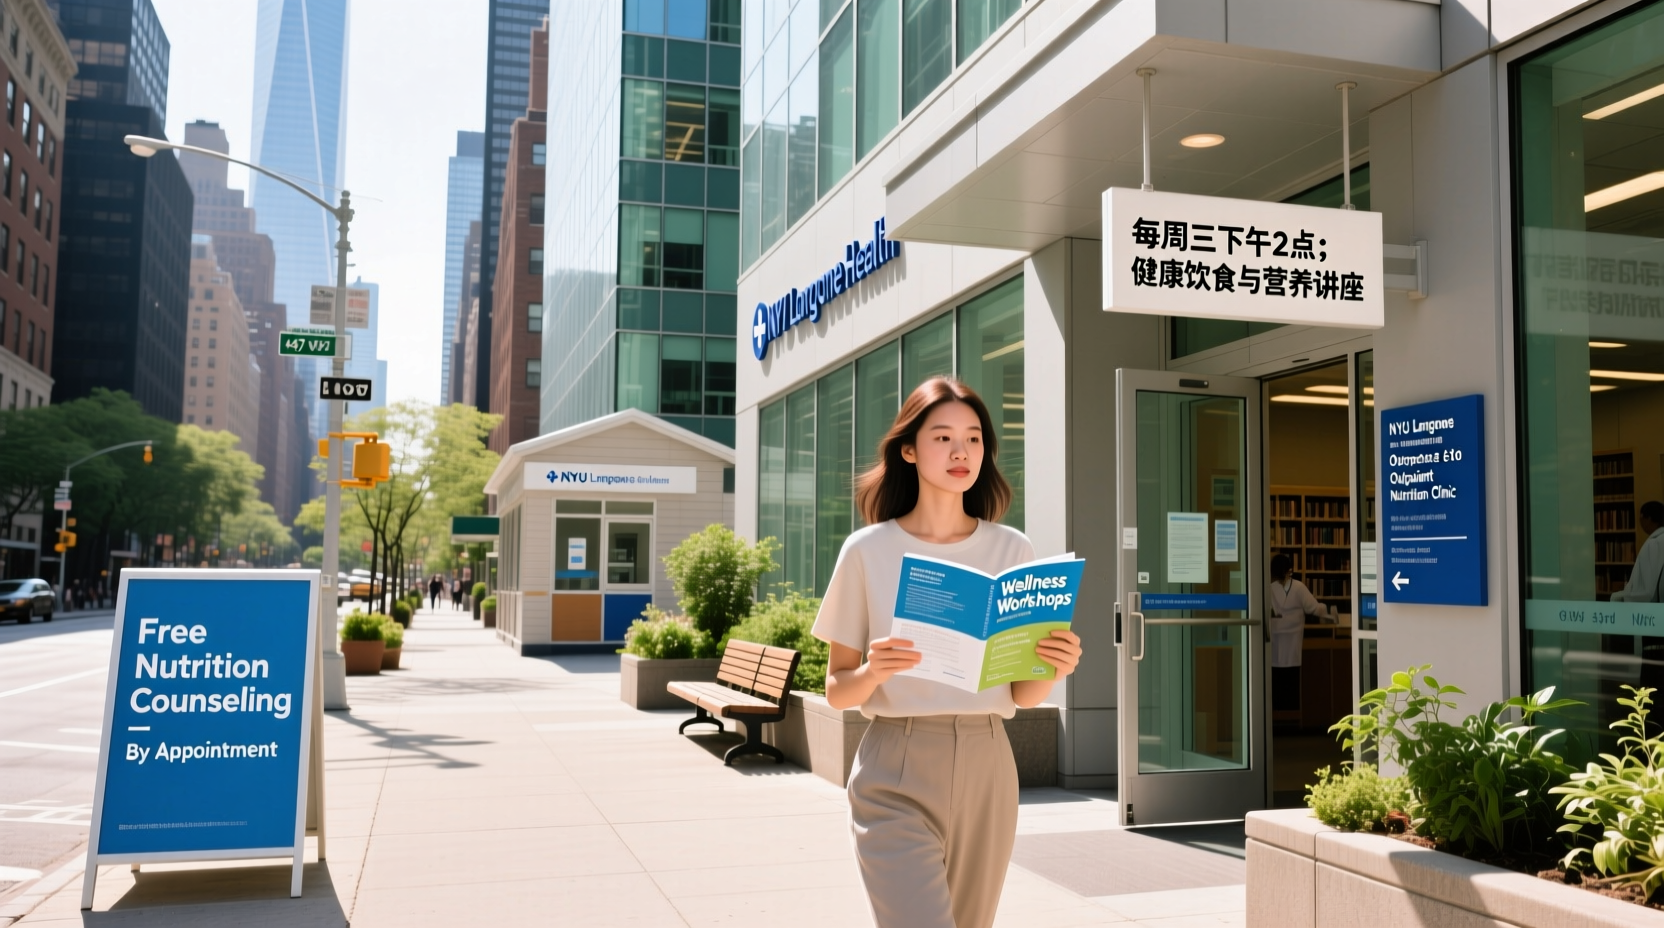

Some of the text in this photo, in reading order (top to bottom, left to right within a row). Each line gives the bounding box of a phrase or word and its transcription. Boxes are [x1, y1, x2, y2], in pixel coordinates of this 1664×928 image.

[1131, 256, 1364, 301] 健康饮食与营养讲座
[1389, 421, 1410, 436] NYU
[560, 471, 587, 483] NYU
[1001, 574, 1067, 597] Wellness
[138, 618, 207, 644] Free
[135, 652, 269, 679] Nutrition
[130, 686, 292, 719] Counseling
[126, 741, 278, 765] By Appointment
